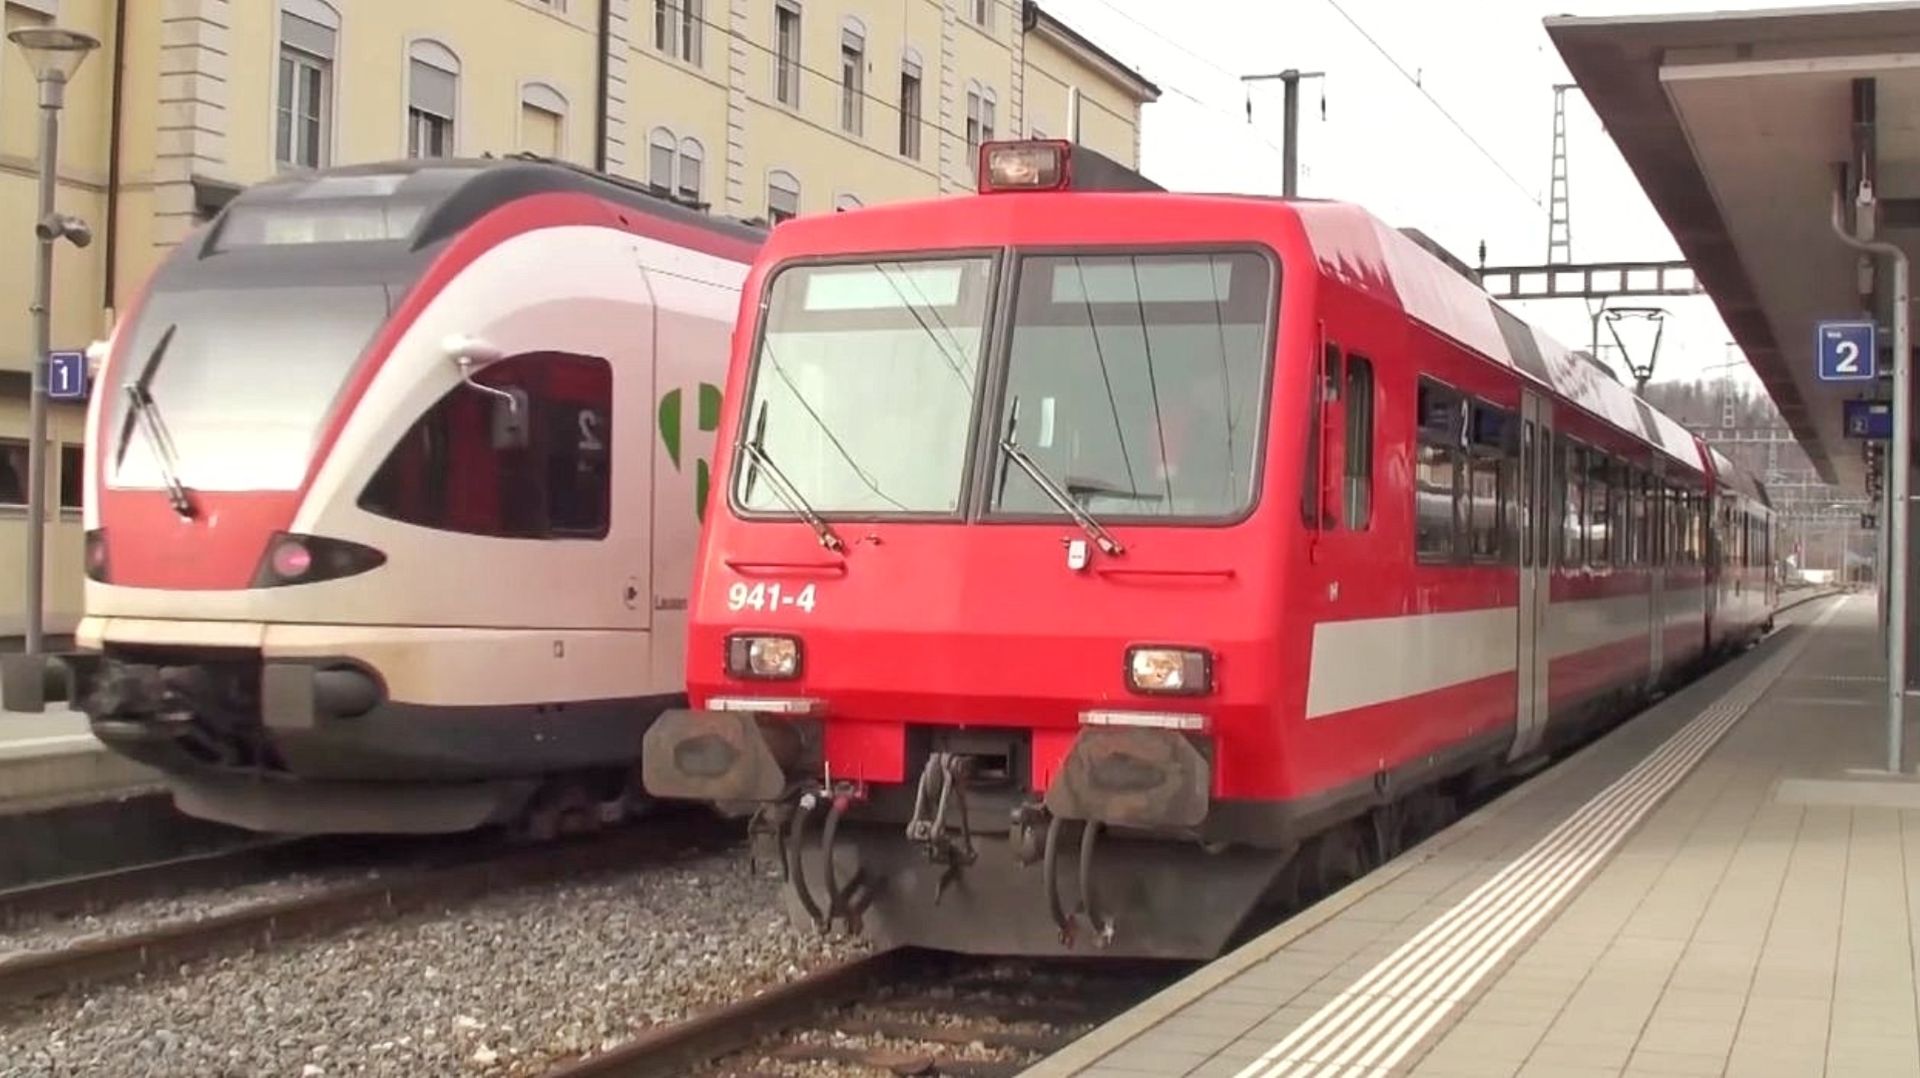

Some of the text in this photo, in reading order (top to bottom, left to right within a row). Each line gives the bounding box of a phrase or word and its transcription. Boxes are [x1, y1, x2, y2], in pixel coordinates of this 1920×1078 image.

[1836, 341, 1859, 372] 2
[60, 366, 68, 390] 1
[728, 582, 816, 613] 941-4
